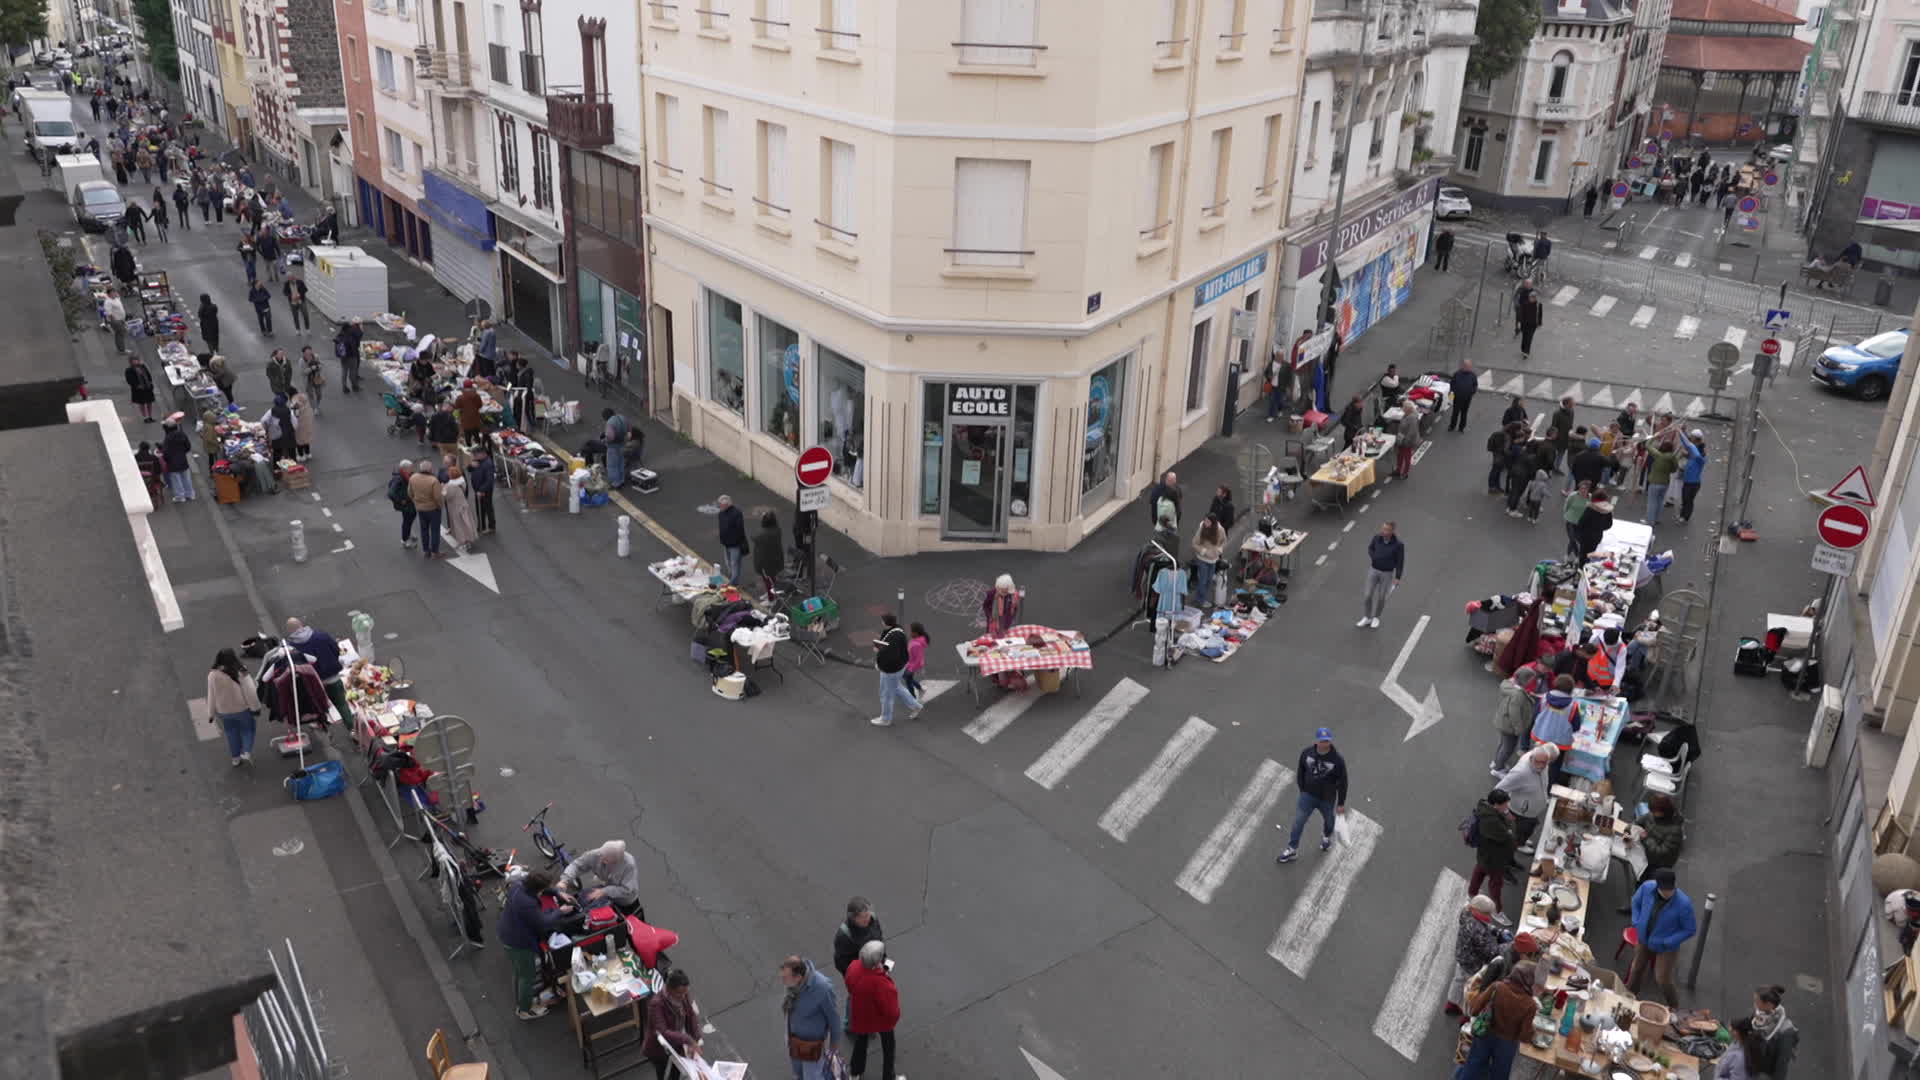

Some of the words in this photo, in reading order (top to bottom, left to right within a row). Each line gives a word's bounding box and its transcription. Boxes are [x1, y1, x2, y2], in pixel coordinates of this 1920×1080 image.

[1315, 218, 1370, 267] RPRO
[1375, 200, 1411, 232] Service
[956, 387, 1006, 400] AUTO
[952, 401, 1008, 414] ECOLE
